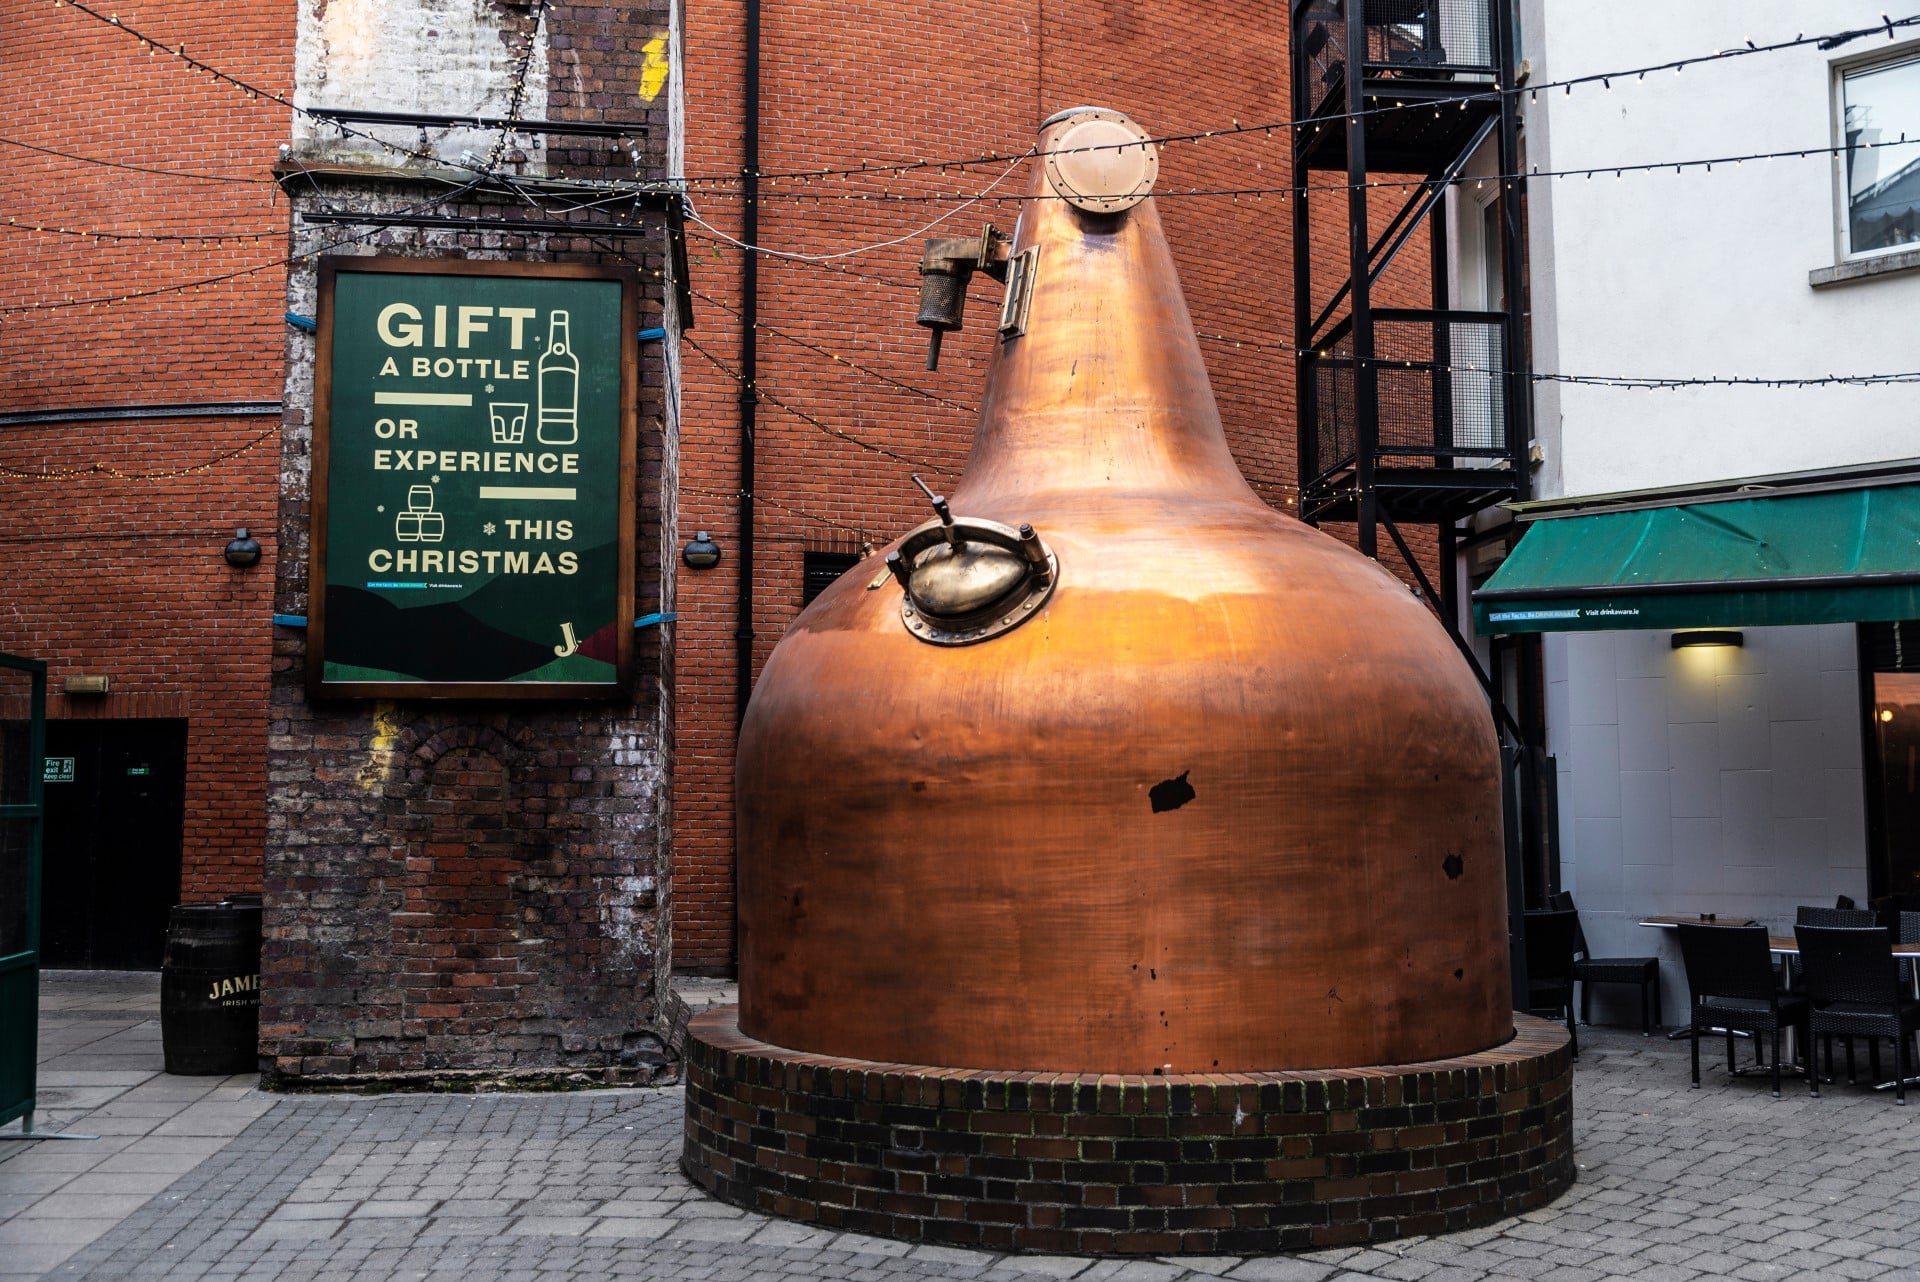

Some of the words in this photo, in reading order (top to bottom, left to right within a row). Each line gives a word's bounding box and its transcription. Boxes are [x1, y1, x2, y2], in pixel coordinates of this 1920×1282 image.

[376, 302, 537, 350] GIFT
[379, 356, 400, 377] A
[412, 356, 530, 380] BOTTLE
[374, 418, 418, 440] OR
[374, 449, 580, 474] EXPERIENCE
[504, 519, 574, 541] THIS
[368, 548, 579, 575] CHRISTMAS
[1600, 608, 1640, 616] drinkaware.ie
[46, 759, 60, 767] Fire
[222, 999, 247, 1007] IRISH
